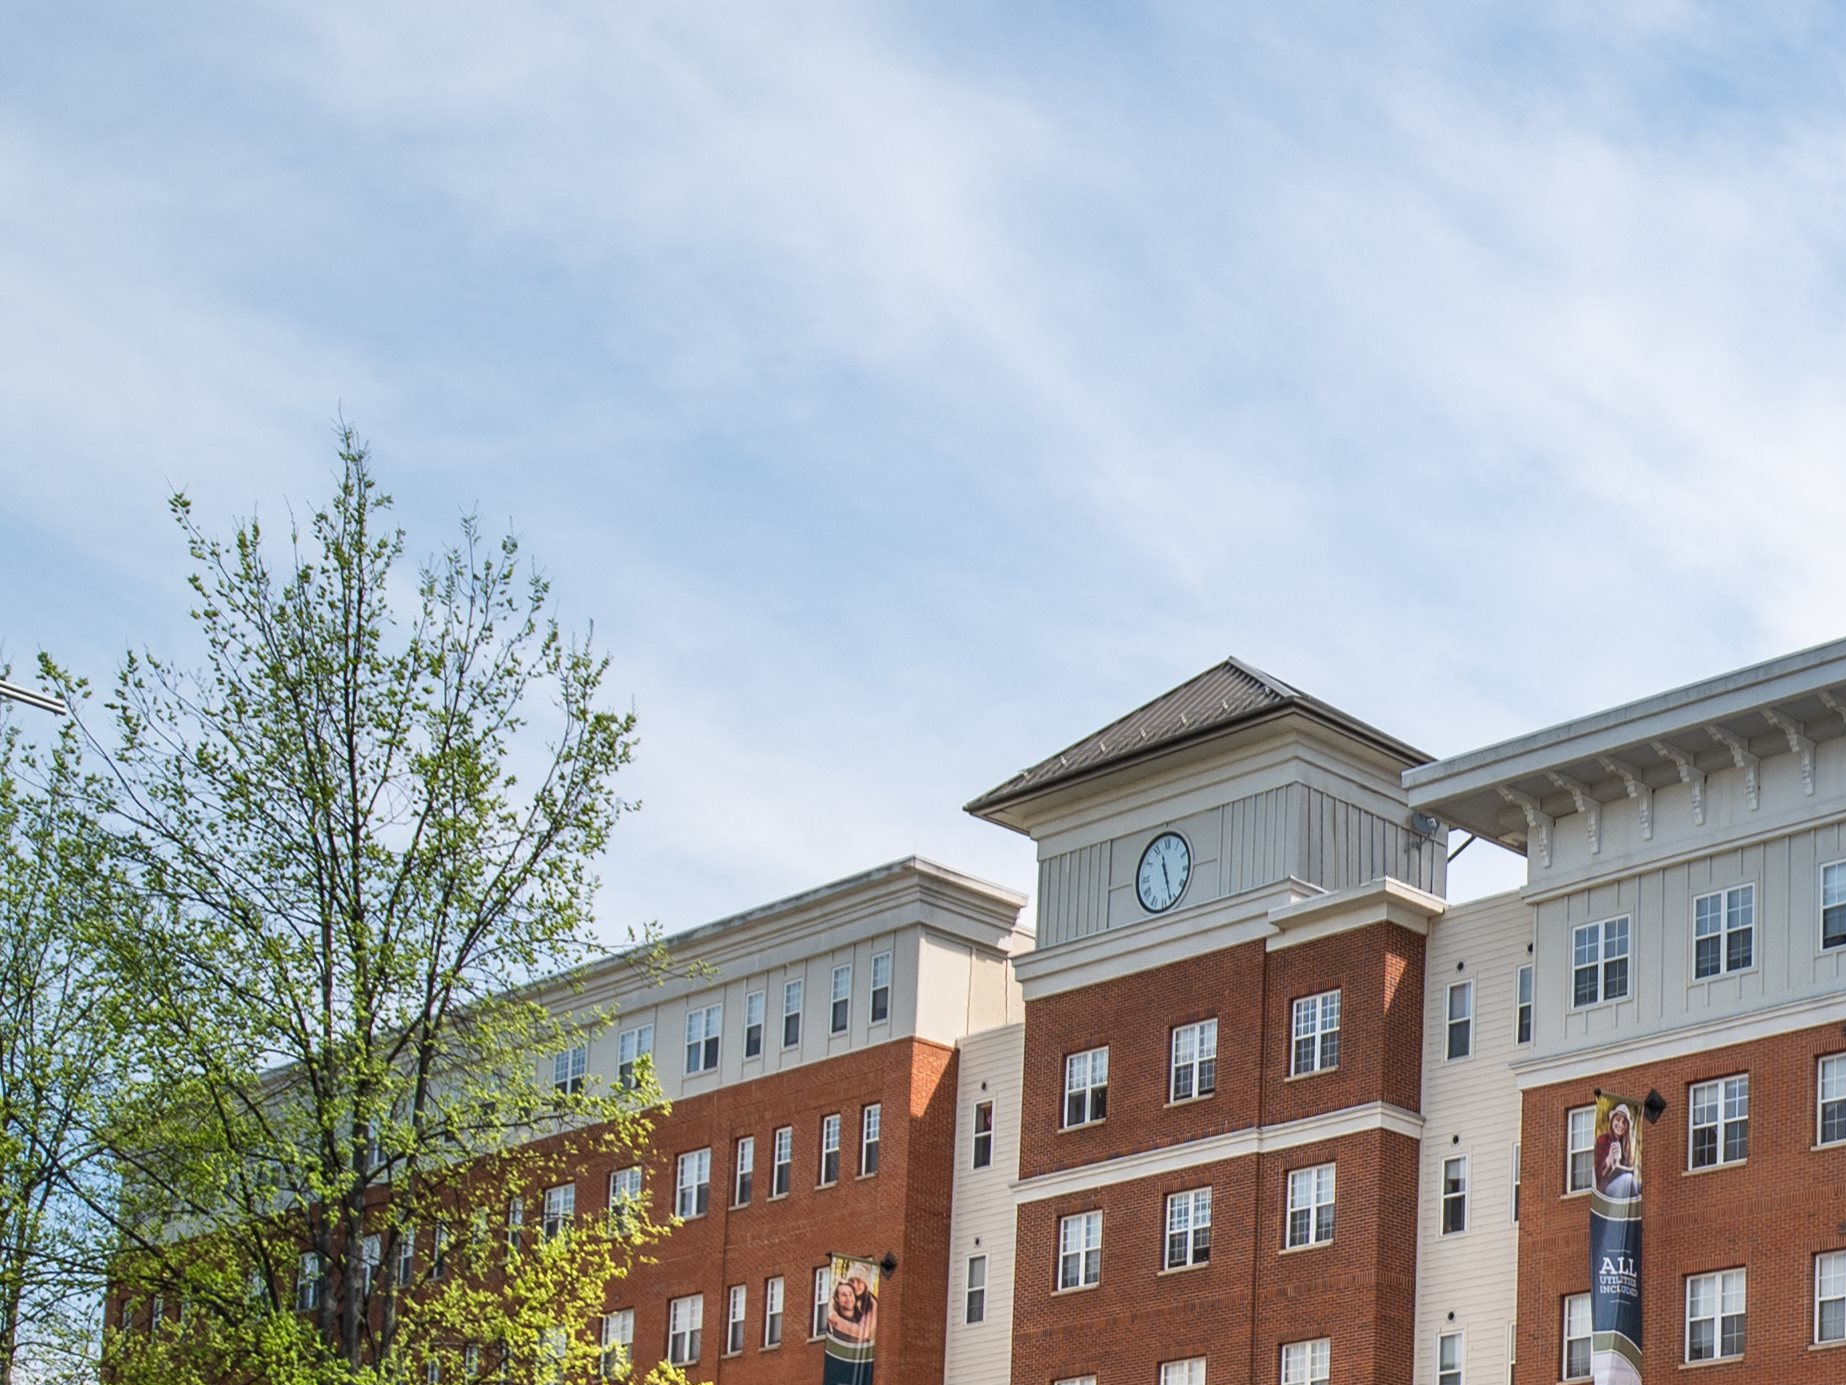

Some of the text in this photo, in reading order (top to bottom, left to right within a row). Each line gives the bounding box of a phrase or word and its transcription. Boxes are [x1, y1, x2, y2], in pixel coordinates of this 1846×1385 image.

[1599, 1256, 1637, 1278] ALL
[1599, 1275, 1637, 1287] UTILITIES
[1600, 1285, 1638, 1297] INCLUDED
